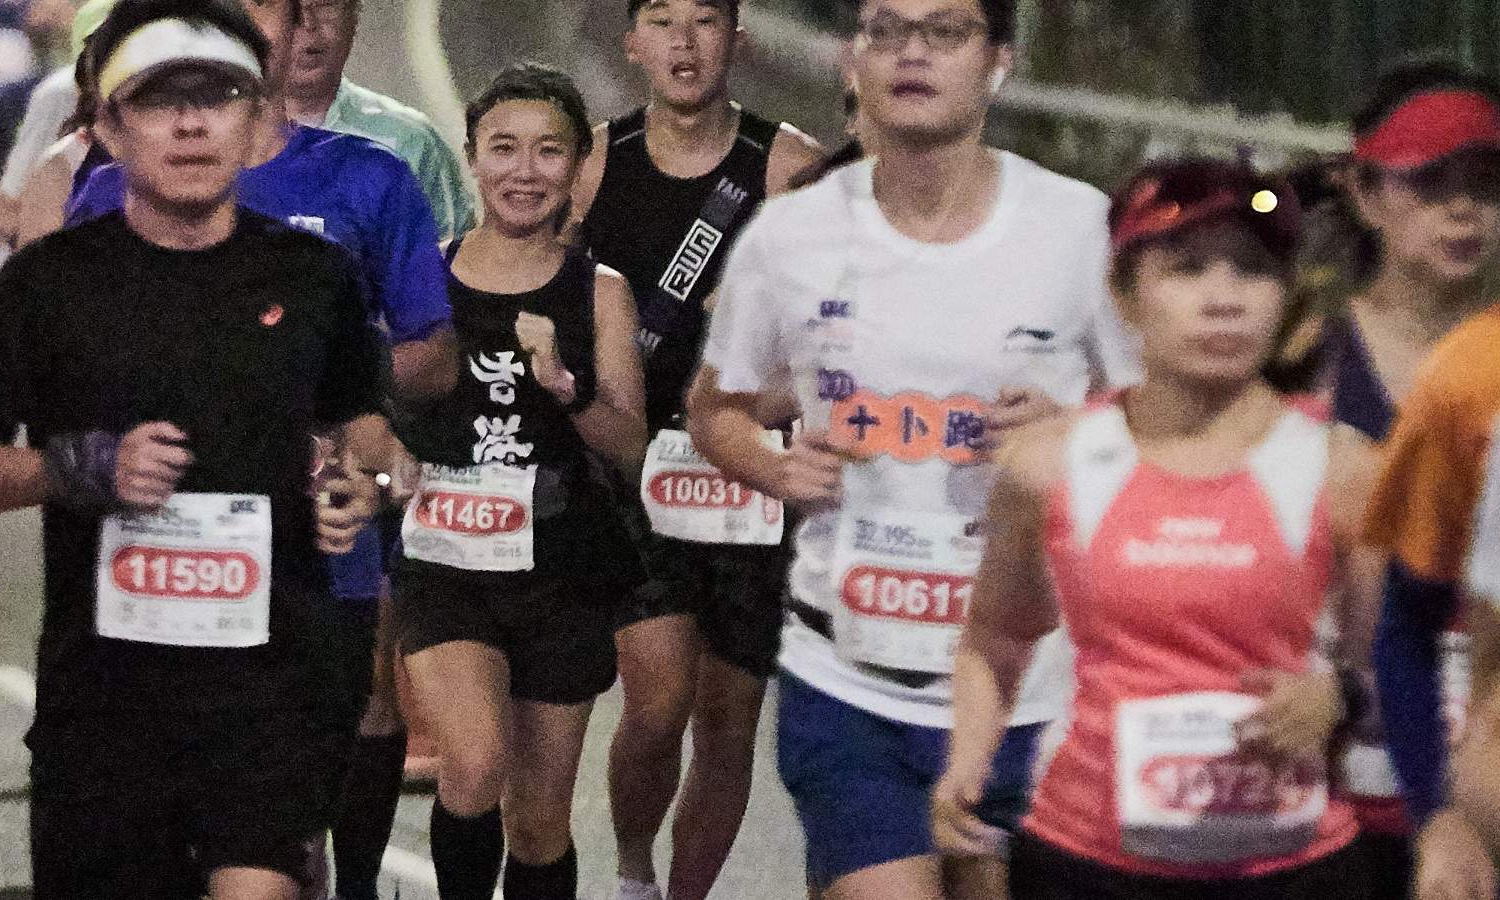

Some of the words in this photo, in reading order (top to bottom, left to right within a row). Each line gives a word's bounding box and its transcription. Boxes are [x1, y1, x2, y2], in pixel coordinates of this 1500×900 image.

[663, 224, 719, 300] RUN
[661, 477, 741, 505] 10031
[427, 496, 513, 529] 11467
[129, 553, 246, 593] 11590
[857, 573, 973, 618] 10611
